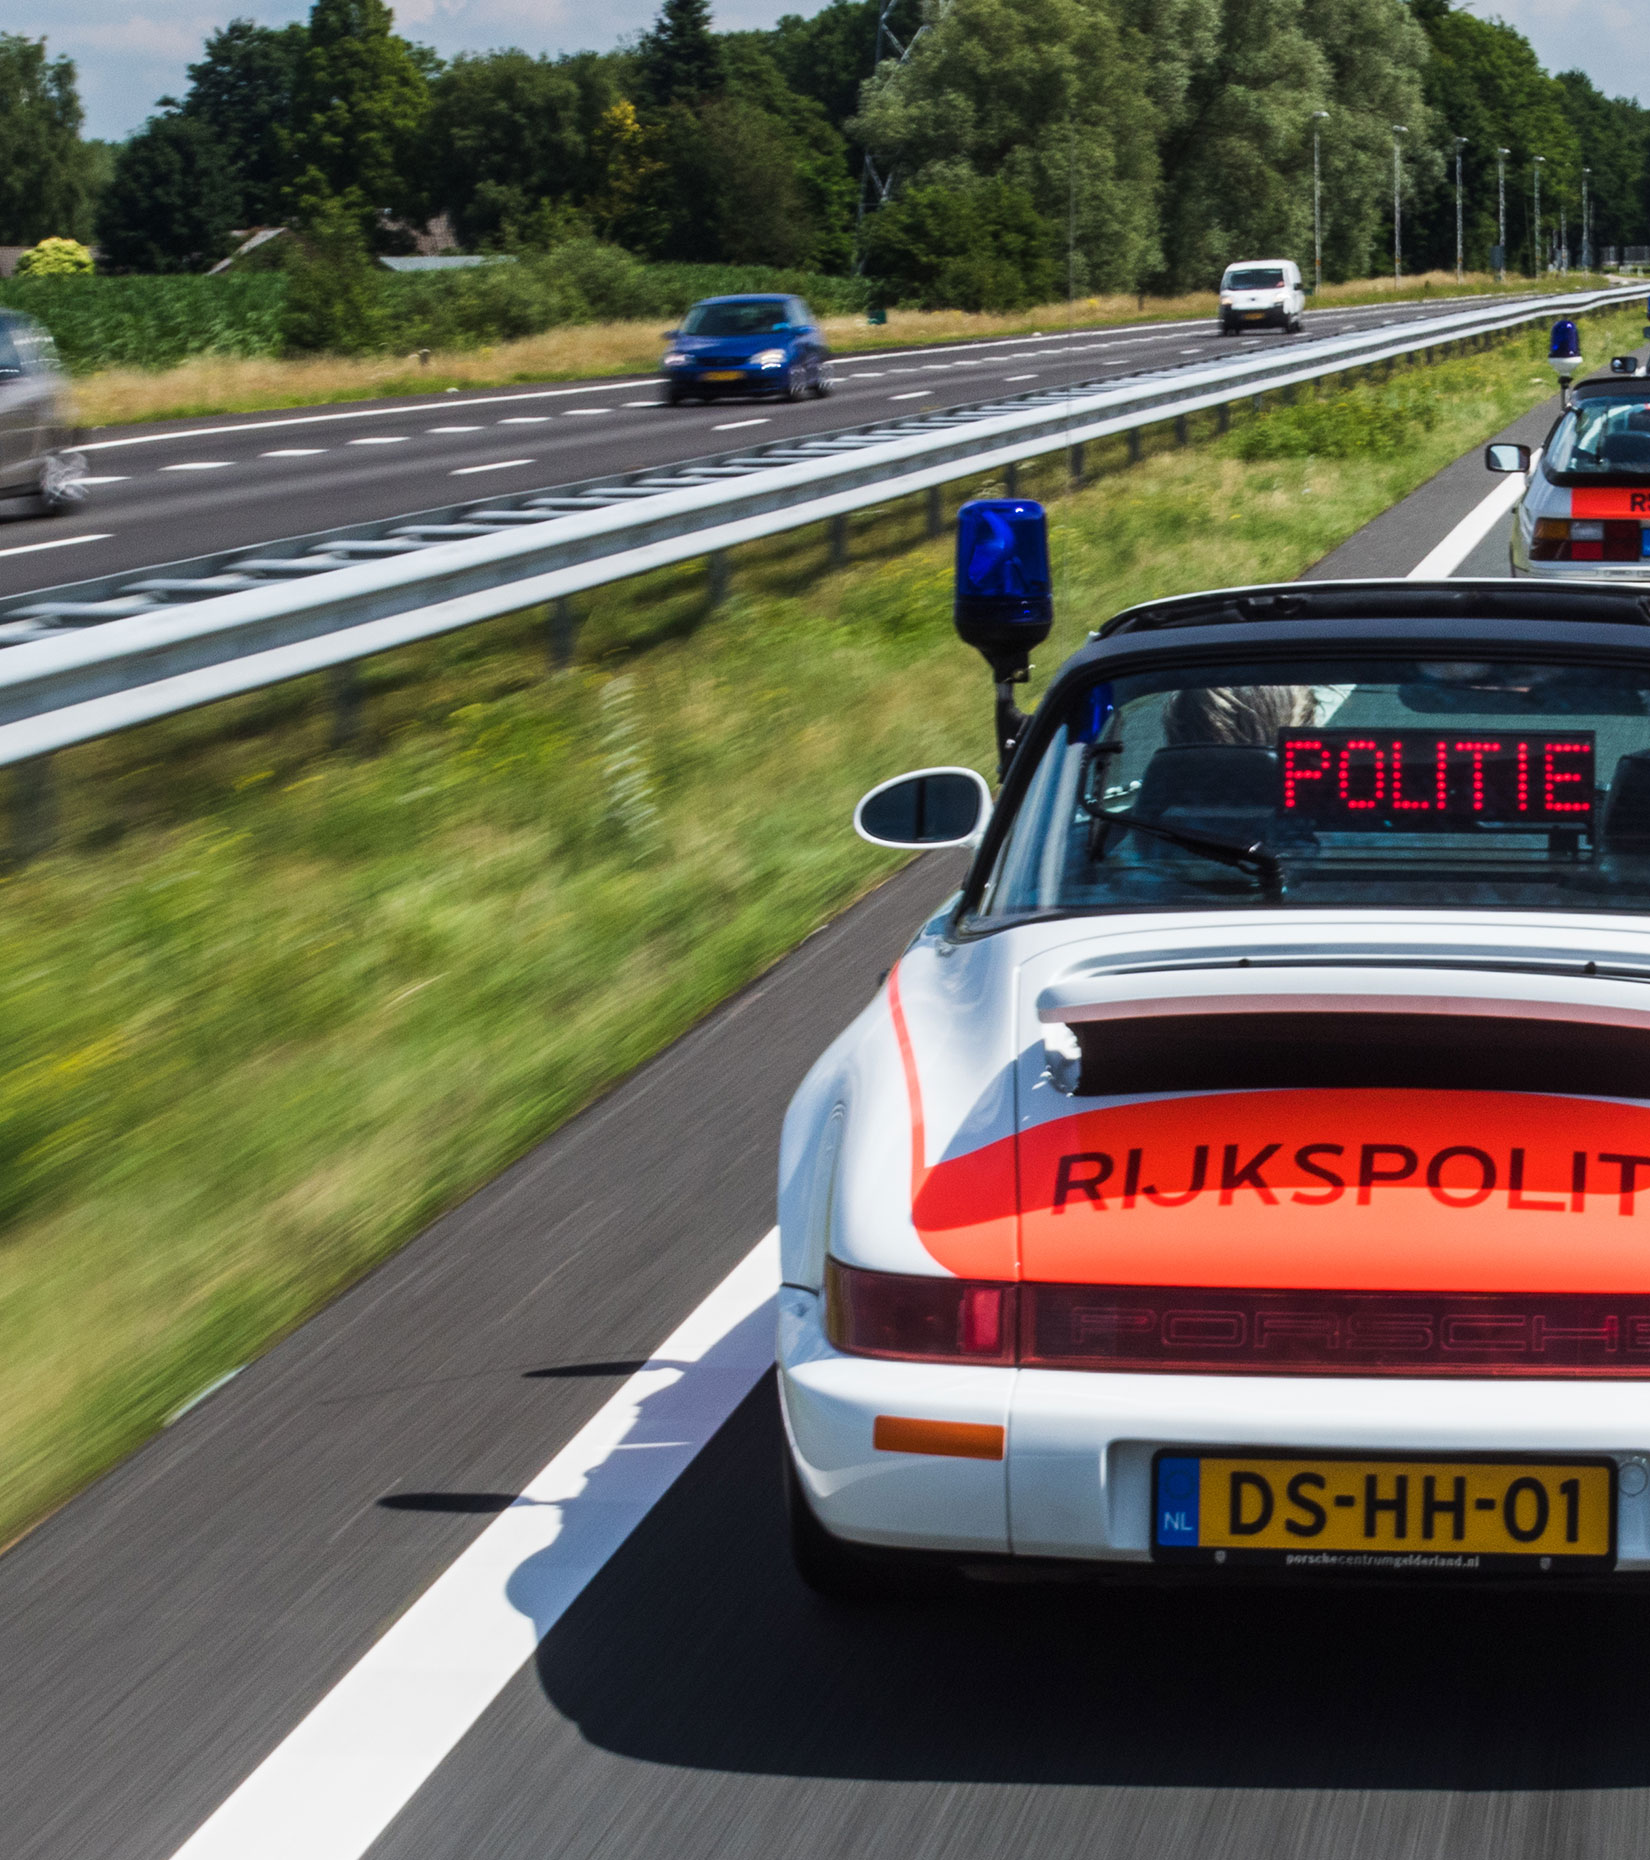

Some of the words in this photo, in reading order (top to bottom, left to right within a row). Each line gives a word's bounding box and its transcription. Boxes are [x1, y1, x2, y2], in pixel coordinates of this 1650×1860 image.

[1285, 741, 1591, 811] POLITIE
[1163, 1511, 1193, 1532] NL
[1229, 1470, 1580, 1544] DS-HH-01
[1286, 1552, 1480, 1568] porschecentrumgelderland.nl
